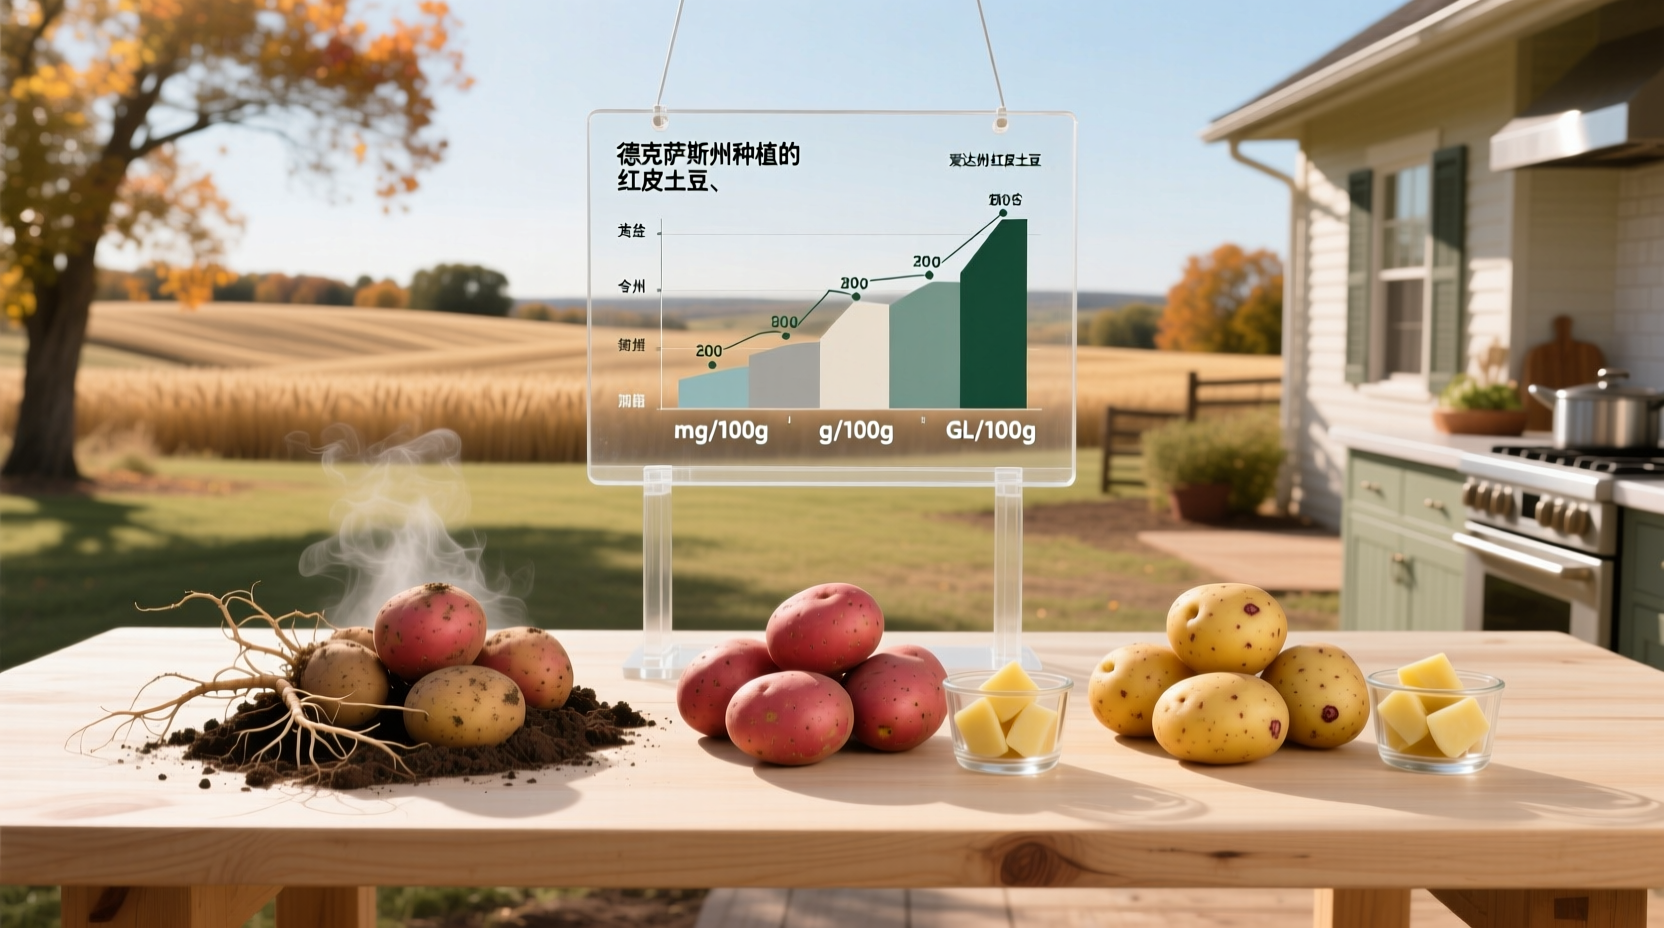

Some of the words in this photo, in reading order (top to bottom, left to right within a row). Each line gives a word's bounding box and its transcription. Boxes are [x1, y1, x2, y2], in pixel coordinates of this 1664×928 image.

[616, 141, 800, 166] 德克萨斯州种植的
[913, 255, 941, 268] 200
[695, 344, 723, 358] 200
[674, 419, 769, 445] mg/100g
[819, 419, 894, 445] g/100g
[945, 419, 1036, 445] GL/100g
